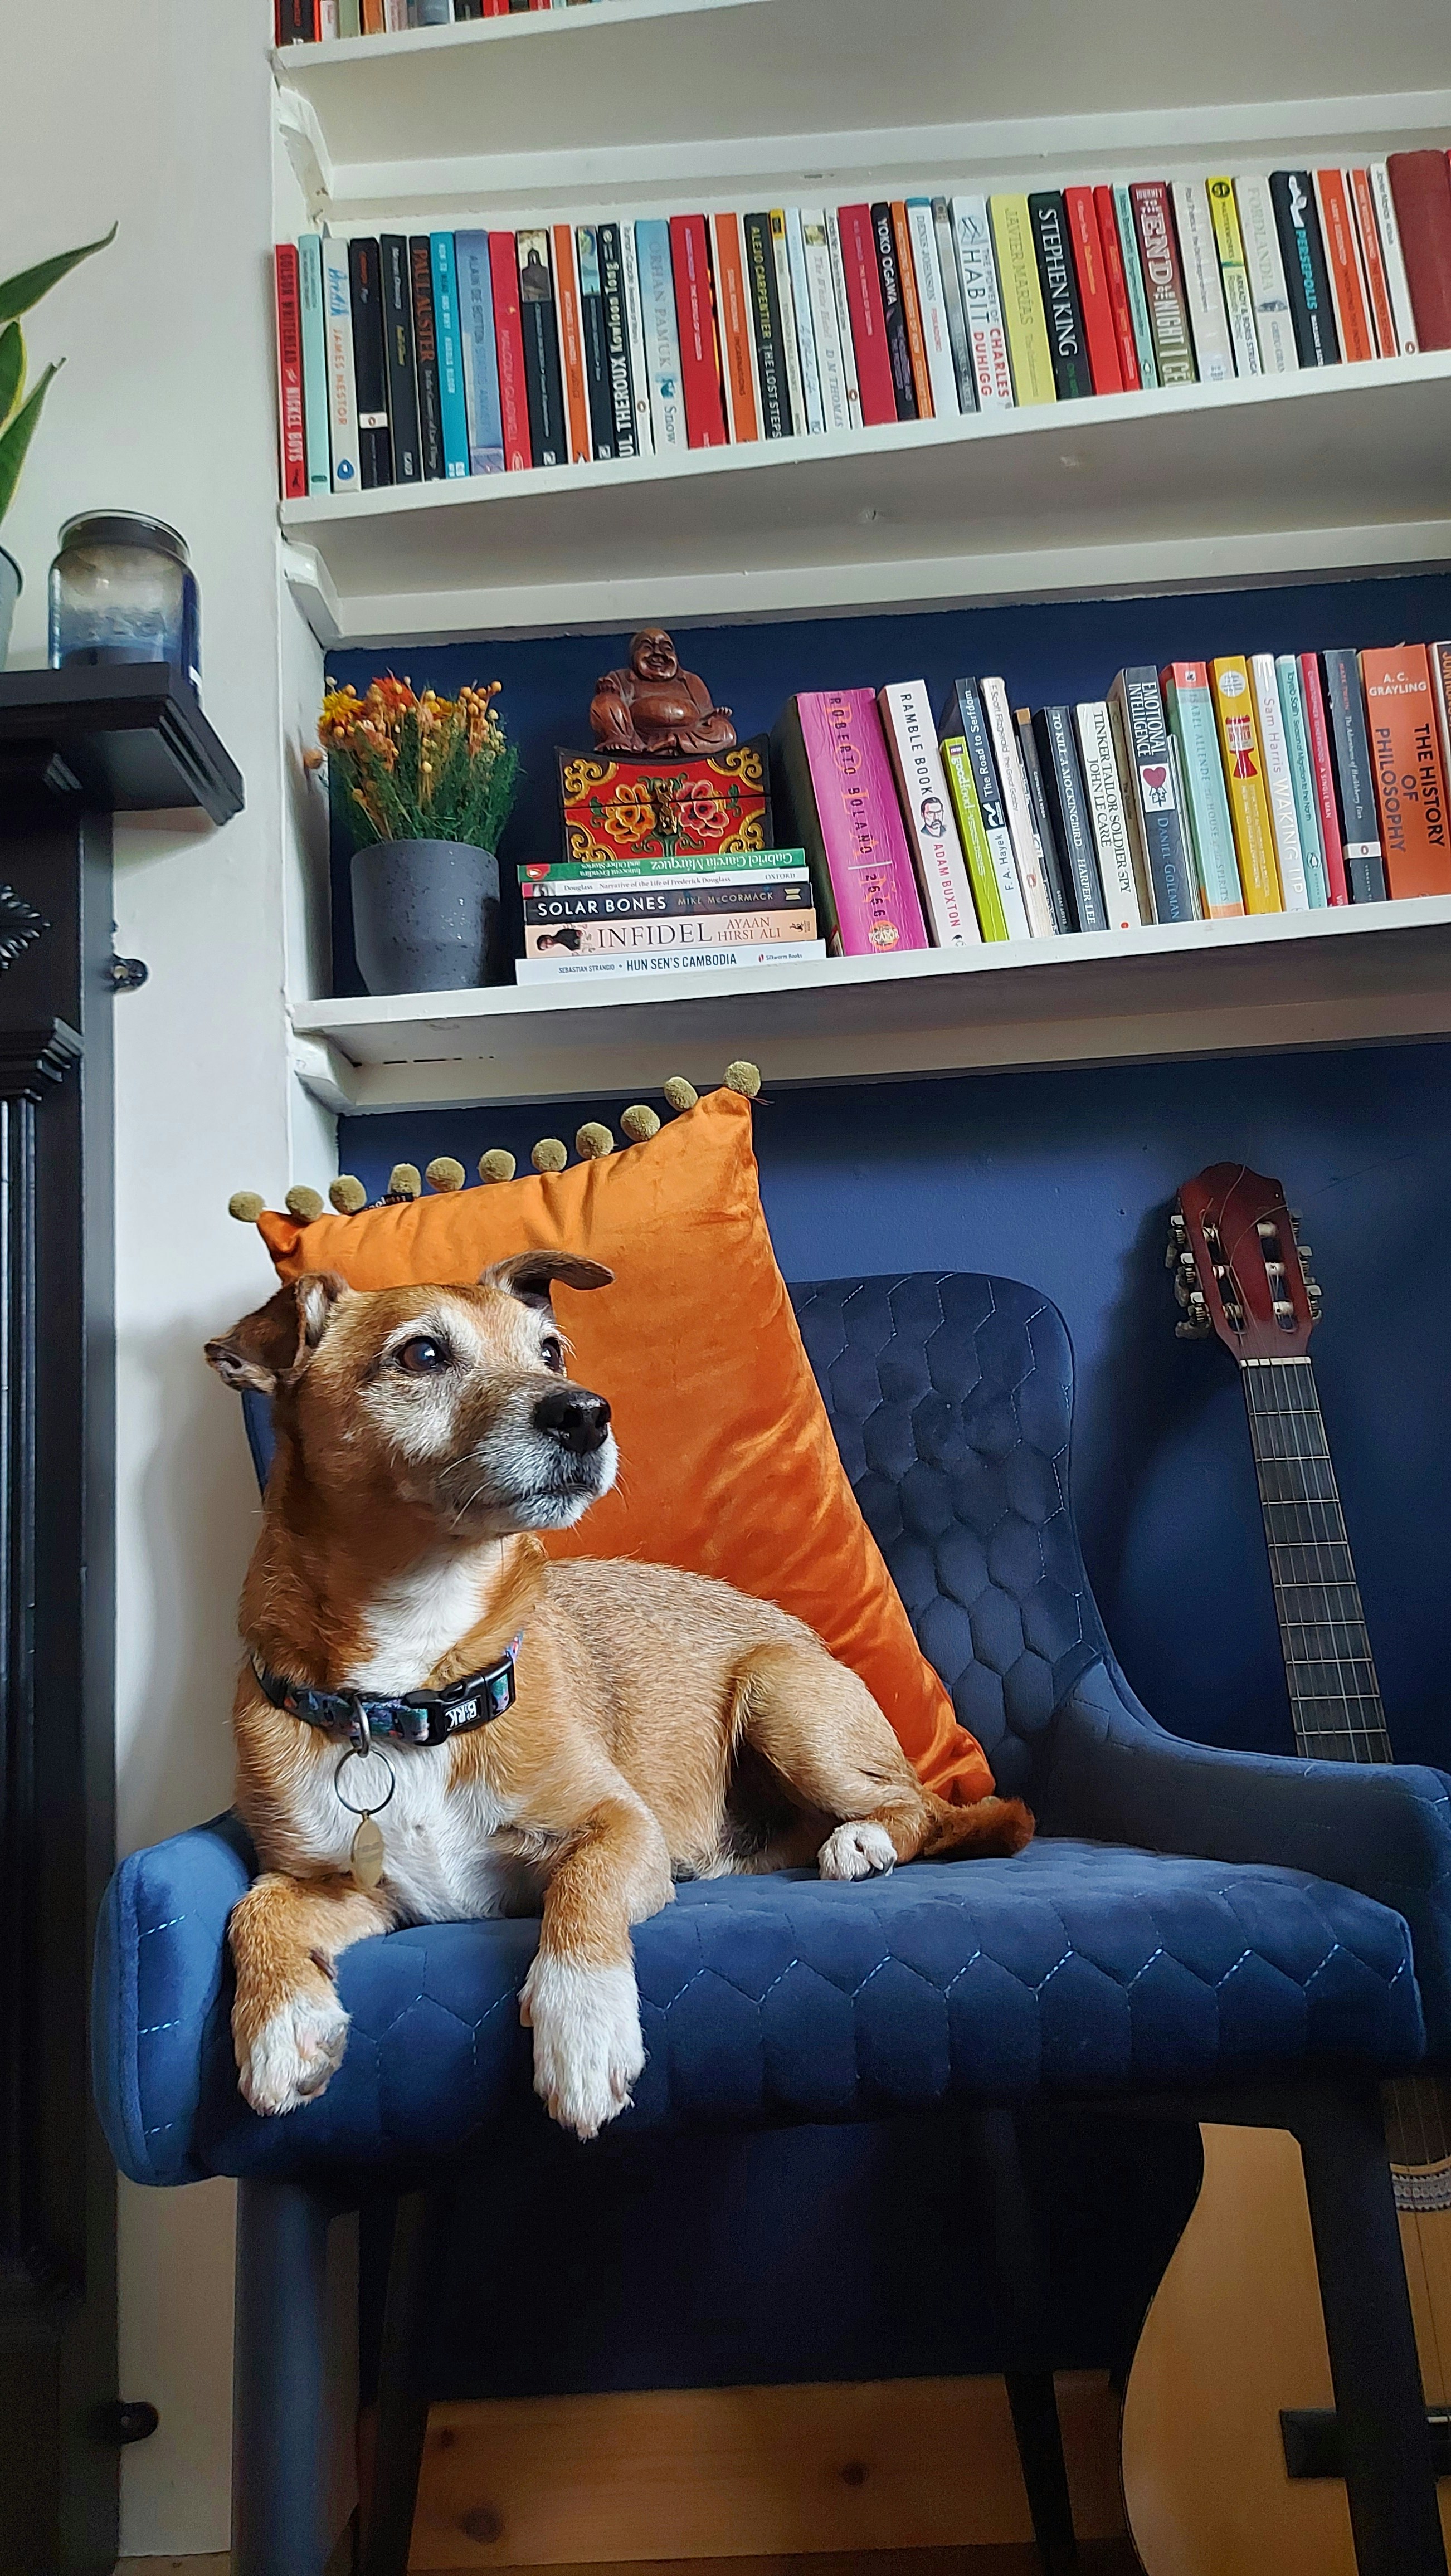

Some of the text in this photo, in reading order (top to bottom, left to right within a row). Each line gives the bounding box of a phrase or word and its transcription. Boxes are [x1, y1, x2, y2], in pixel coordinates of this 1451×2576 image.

[915, 214, 936, 302] DENIS JOHNSON
[1140, 211, 1174, 286] END
[1220, 201, 1235, 258] MASTERWORKS
[1246, 186, 1275, 291] FORDLANDIA
[751, 226, 772, 339] ALEJO CARPENTIER
[814, 256, 824, 275] The
[876, 218, 899, 307] YOKO OGAWA
[962, 248, 990, 325] HABIT
[981, 248, 999, 323] THE POWER OF
[1004, 207, 1037, 326] JAVIER MARÍAS
[1037, 207, 1078, 357] STEPHEN KING
[1294, 228, 1318, 311] PERSEPOLIS
[413, 249, 434, 362] PAUL AUSTER
[470, 288, 481, 304] DE
[602, 261, 624, 352] Kowloon Tong
[649, 242, 671, 367] ORHAN PAMUK
[1153, 298, 1185, 347] NIGHT
[1226, 275, 1245, 340] Roadside Picnic
[1235, 274, 1247, 306] ARKADY
[1241, 316, 1252, 341] BORIS
[333, 328, 347, 424] JAMES NESTOR
[610, 355, 632, 431] THEROUX
[762, 343, 782, 438] THE LOST STEPS
[825, 348, 843, 428] D M THOMAS
[973, 331, 993, 397] DUHIGG
[988, 327, 1009, 398] CHARLES
[285, 388, 302, 464] NICKEL BOYS
[663, 406, 679, 445] Snow
[1285, 670, 1299, 717] Tayeb Salih
[1338, 662, 1347, 684] MARK
[1367, 680, 1427, 697] GRAYLING
[1384, 671, 1408, 683] A. C.
[899, 693, 932, 796] RAMBLE BOOK
[962, 689, 994, 797] The Road to Serfdom
[991, 691, 1010, 754] Scott Fitzgerald
[1128, 687, 1151, 758] INTELLIGENCE
[1142, 685, 1167, 756] EMOTIONAL
[1187, 692, 1211, 782] ISABEL ALLENDE
[1263, 696, 1284, 773] Sam Harris
[1292, 719, 1303, 745] Season
[828, 696, 877, 855] ROBERTO BOLAÑO
[950, 755, 975, 810] goodfood
[1005, 768, 1015, 788] Great
[1051, 713, 1083, 848] TO KILL A MOCKINGBIRD
[1296, 752, 1308, 783] Migration
[1302, 789, 1311, 802] the
[1320, 774, 1330, 801] SINGLE
[1347, 760, 1357, 769] of
[1350, 769, 1362, 804] Huckleberry
[1374, 726, 1406, 855] PHILOSOPHY
[1400, 773, 1419, 803] OF
[1413, 722, 1445, 848] THE HISTORY
[1008, 787, 1020, 812] Gatsby
[1086, 757, 1113, 848] JOHN LE CARRÉ
[1092, 710, 1131, 894] TINKER TAILOR SOLDIER SPY
[1303, 801, 1313, 822] North
[1323, 801, 1332, 819] MAN
[1355, 805, 1364, 819] Finn
[651, 852, 792, 871] Gabriel García Márquez
[973, 845, 986, 876] DISHES
[993, 833, 1009, 865] Hayek
[1205, 802, 1230, 902] HOUSE SPIRITS
[1271, 777, 1304, 895] WAKING UP
[599, 881, 629, 890] Narrative
[670, 877, 700, 886] Frederick
[702, 876, 731, 885] Douglass
[677, 891, 774, 906] MIKE McCORMACK
[865, 873, 885, 918] 2666
[933, 843, 960, 928] ADAM BUXTON
[1001, 867, 1011, 879] A.
[1004, 880, 1014, 890] F.
[1076, 857, 1096, 924] HARPER LEE
[538, 896, 667, 917] SOLAR BONES
[597, 923, 713, 949] INFIDEL
[718, 928, 781, 942] HIRSI ALI
[726, 917, 771, 930] AYAAN
[867, 926, 899, 945] PICADOR
[1055, 890, 1068, 925] GREAT LOVES
[558, 964, 615, 974] SEBASTIAN STRANGIO
[626, 953, 737, 972] HUN SEN'S CAMBODIA
